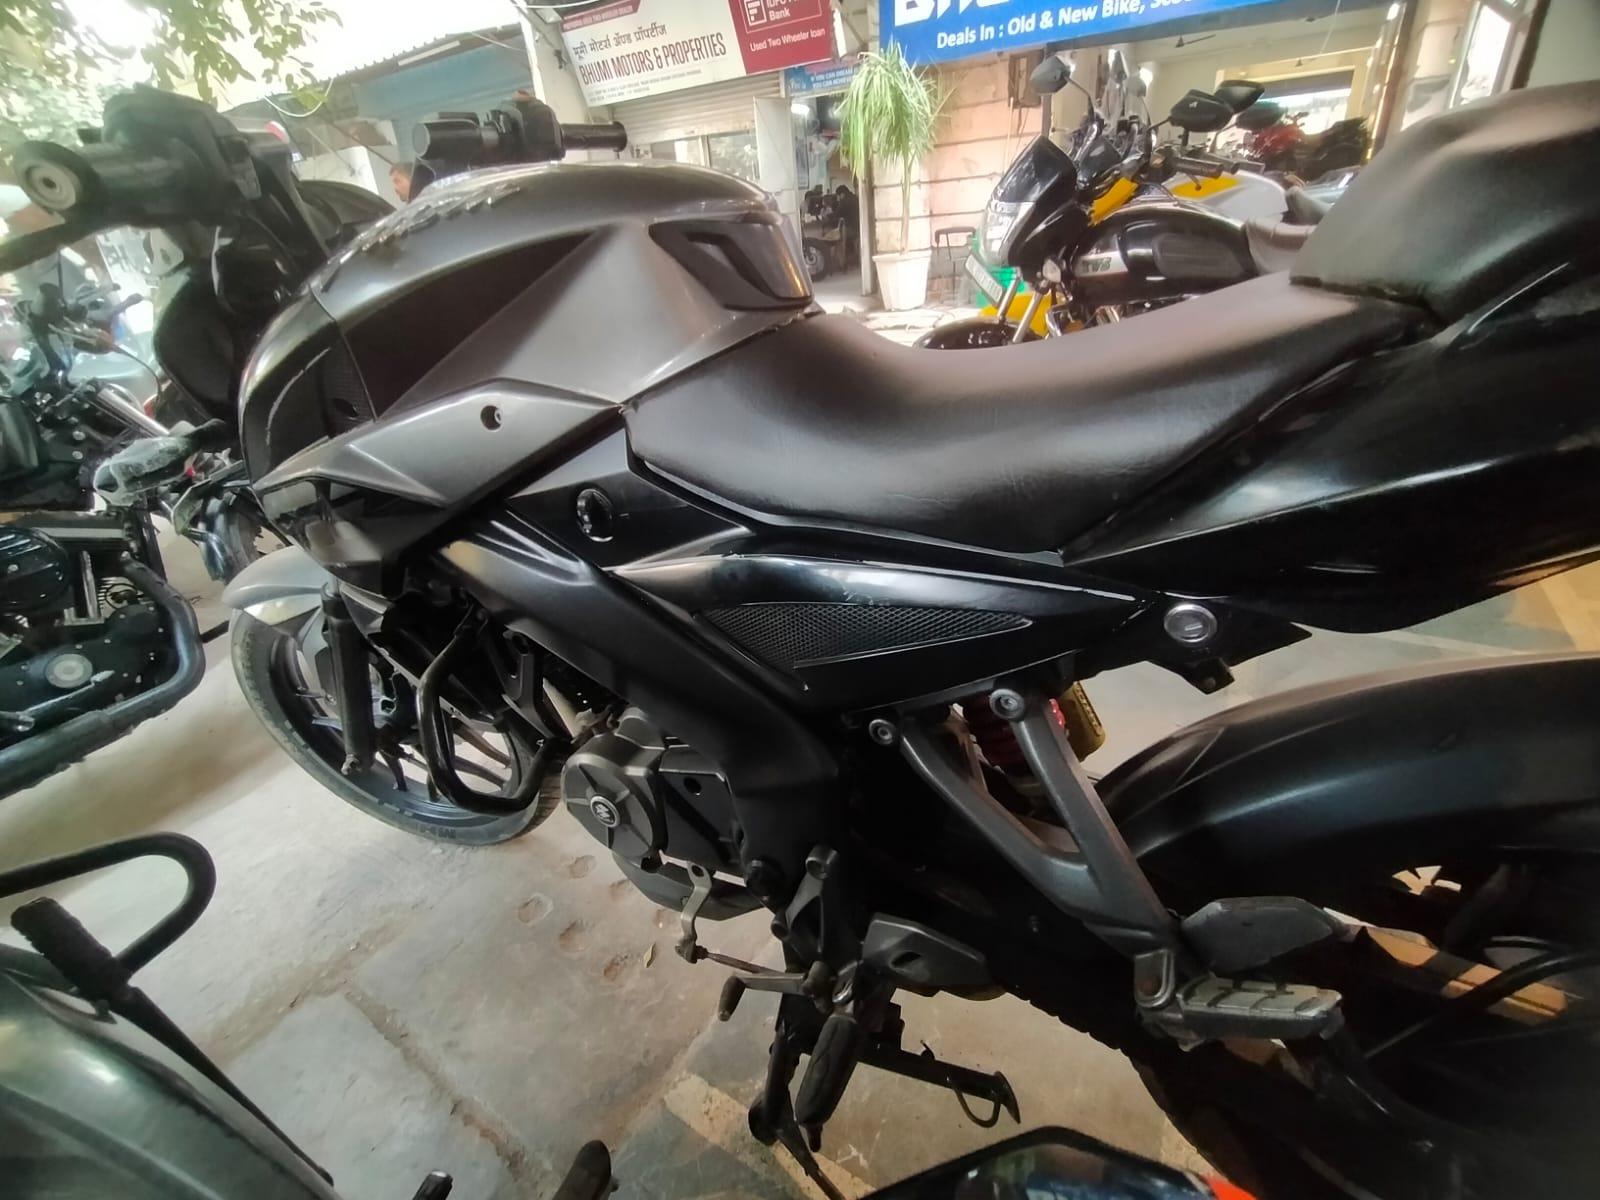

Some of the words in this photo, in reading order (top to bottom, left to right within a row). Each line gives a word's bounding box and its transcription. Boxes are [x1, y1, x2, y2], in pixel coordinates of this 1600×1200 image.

[768, 7, 791, 21] Bank
[937, 27, 976, 49] Deals
[980, 24, 995, 41] In
[1007, 13, 1036, 35] Old
[1039, 11, 1054, 29] &
[1058, 5, 1098, 26] New
[1102, 0, 1145, 18] Bike,
[578, 59, 614, 85] BHUMI
[610, 49, 655, 79] MOTORS
[654, 47, 663, 69] &
[662, 32, 727, 67] PROPERTIES
[750, 40, 768, 52] Used
[767, 38, 781, 48] Two
[781, 31, 809, 44] Wheeler
